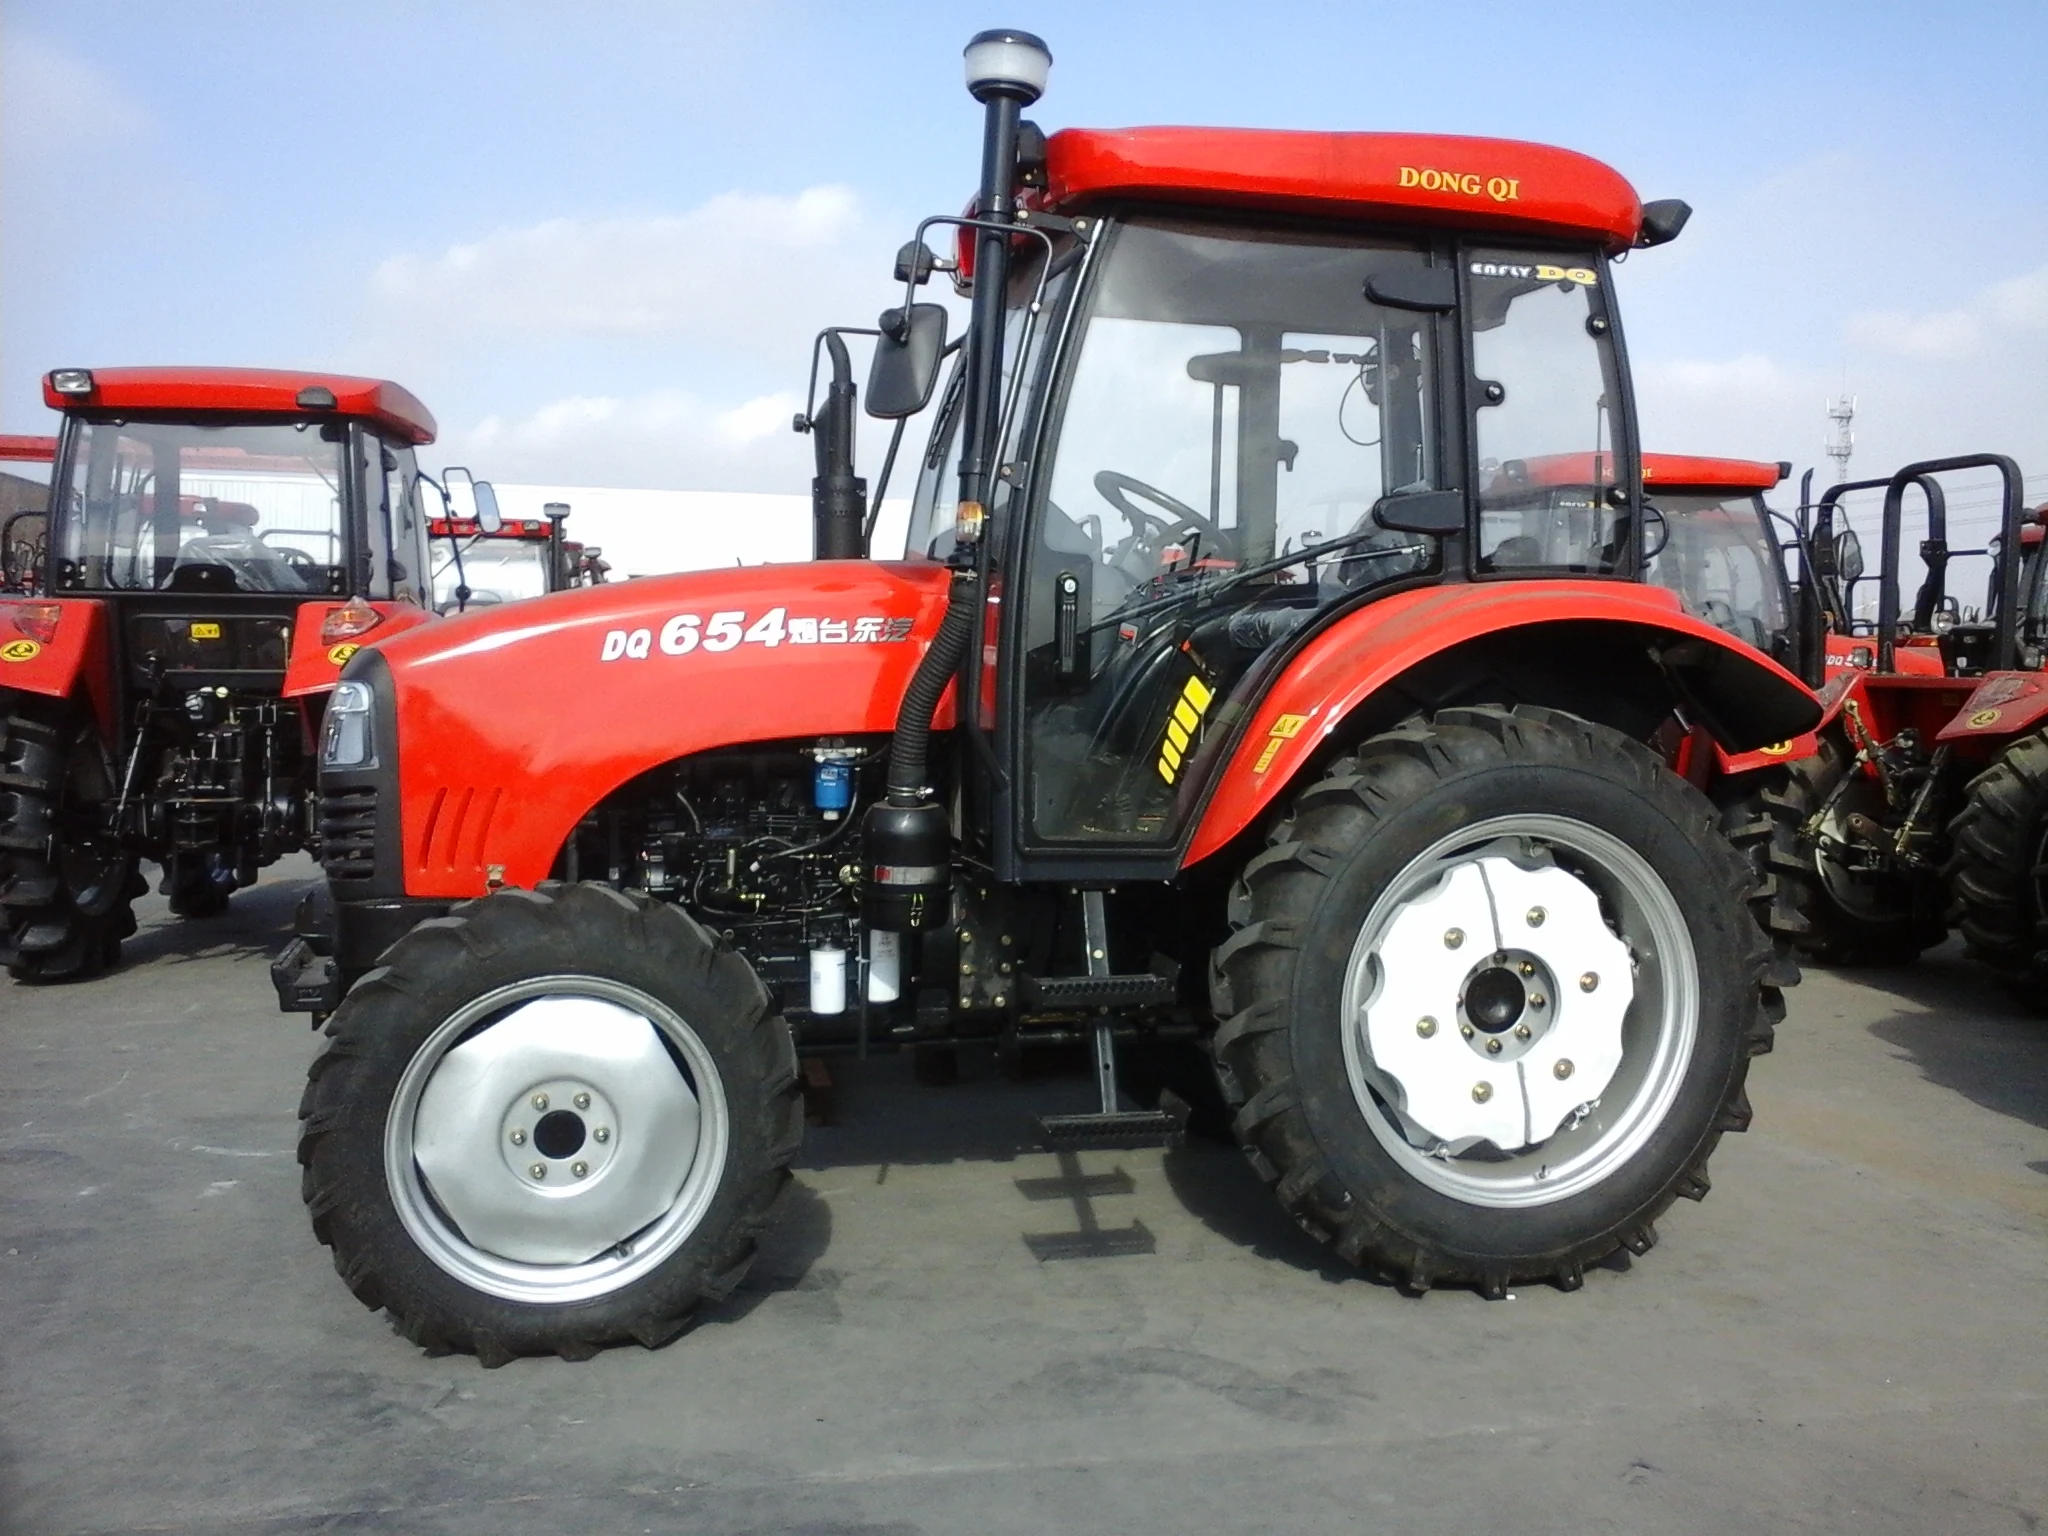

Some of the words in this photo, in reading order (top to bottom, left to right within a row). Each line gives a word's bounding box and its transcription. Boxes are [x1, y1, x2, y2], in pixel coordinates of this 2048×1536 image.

[1399, 166, 1482, 195] DONG
[1487, 177, 1520, 202] QI
[600, 629, 652, 662] DQ
[659, 607, 787, 655] 654
